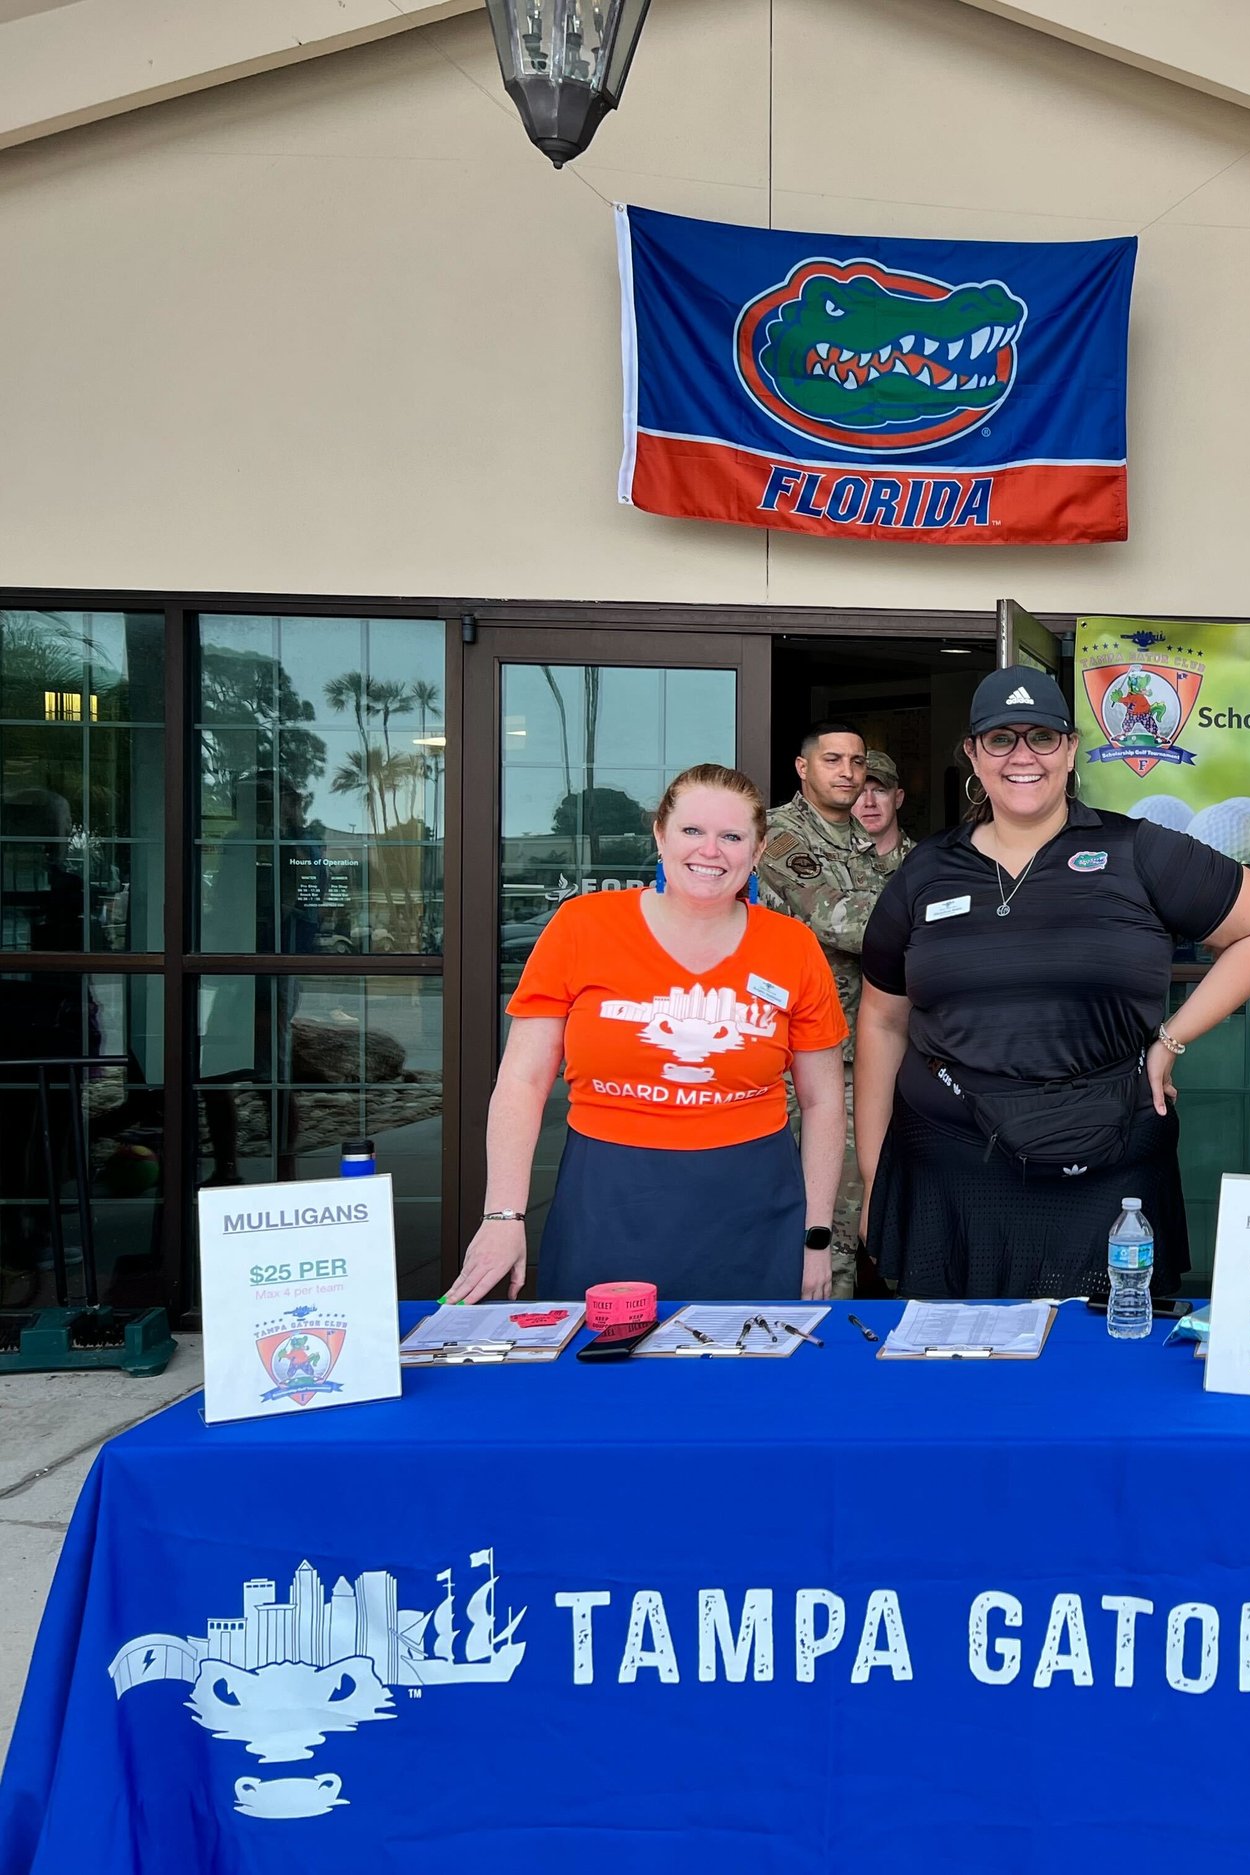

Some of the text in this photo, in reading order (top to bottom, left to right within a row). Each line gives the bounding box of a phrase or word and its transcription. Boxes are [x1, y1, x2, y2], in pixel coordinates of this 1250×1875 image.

[757, 465, 995, 528] FLORIDA
[289, 858, 359, 867] Hours of Operation
[592, 1079, 669, 1102] BOARD
[223, 1203, 369, 1233] MULLIGANS
[250, 1258, 347, 1285] $25 PER
[255, 1282, 344, 1301] Max 4 per team
[593, 1301, 613, 1310] TICKET
[626, 1298, 646, 1309] TICKET
[253, 1320, 348, 1338] TAMPA GATOR CLUB
[554, 1588, 914, 1685] TAMPA
